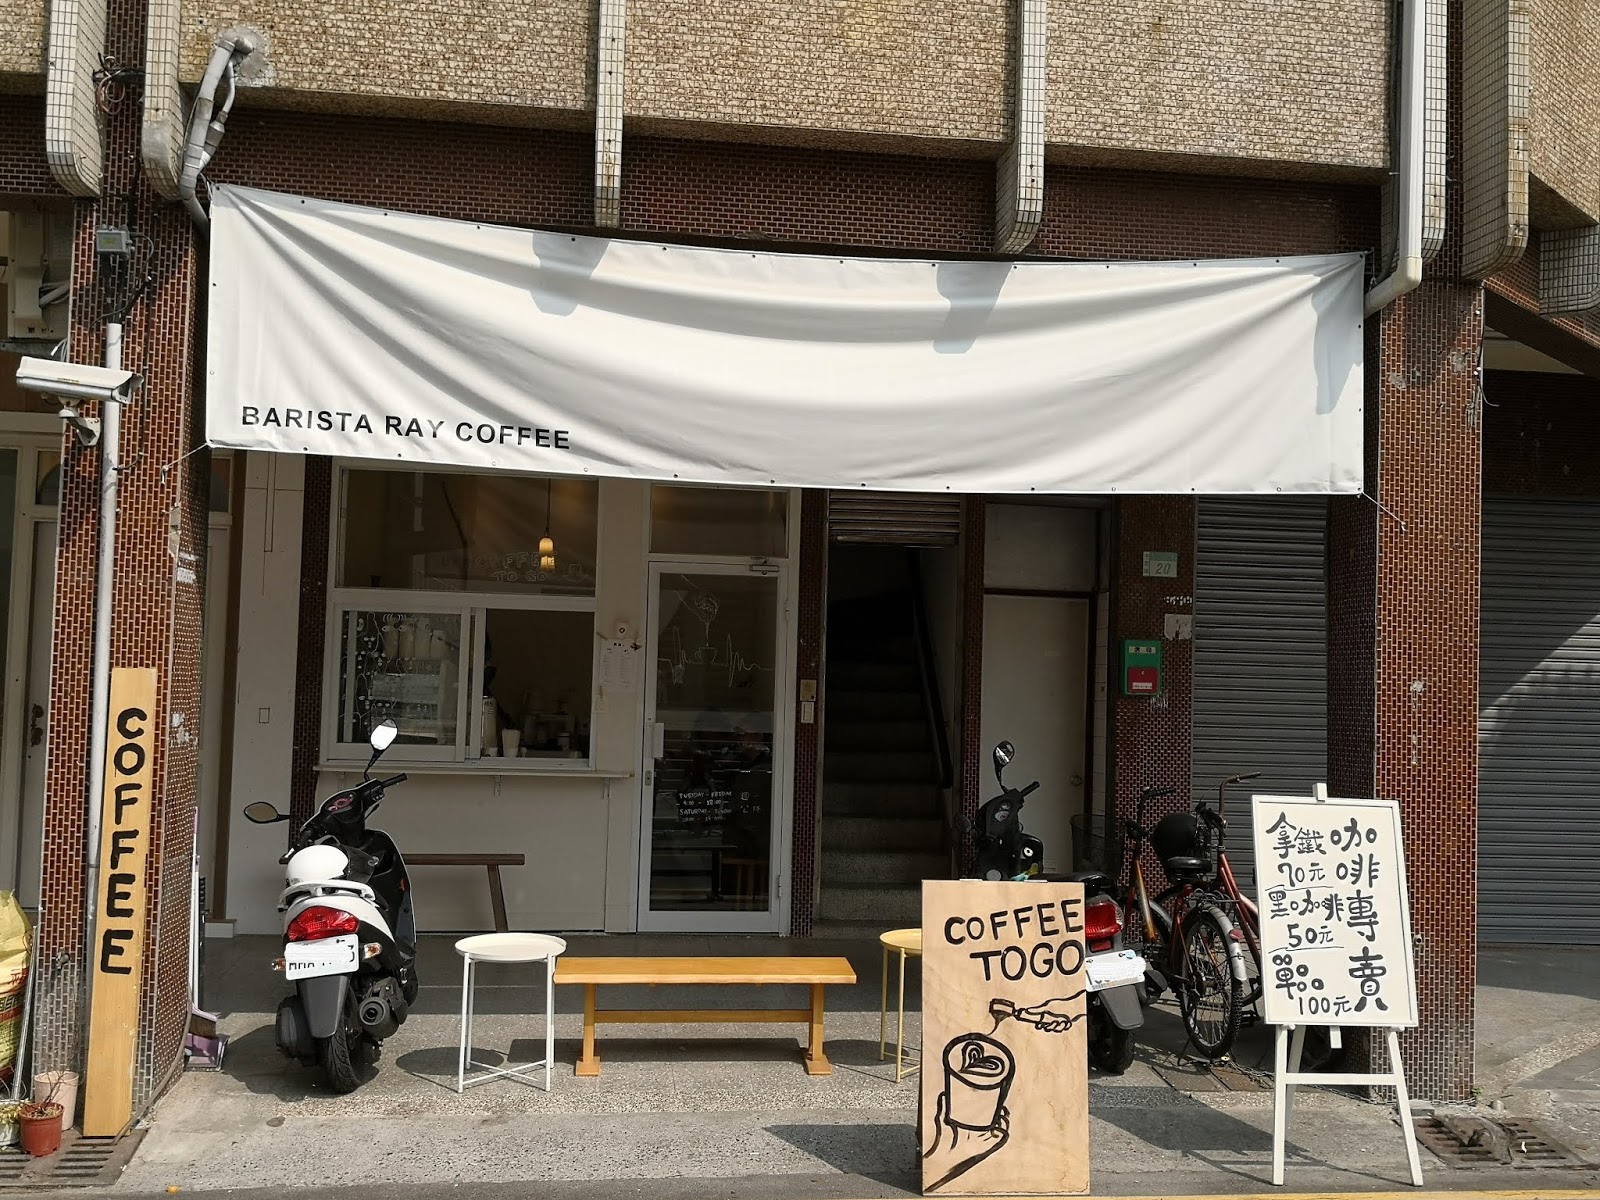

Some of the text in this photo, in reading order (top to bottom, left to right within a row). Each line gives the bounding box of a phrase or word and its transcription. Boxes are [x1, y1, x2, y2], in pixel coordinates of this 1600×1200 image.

[242, 406, 570, 450] BARISTA RAY COFFEE
[100, 707, 148, 975] COFFEE
[1265, 811, 1327, 859] 拿鐵
[944, 899, 1083, 945] COFFEE
[1268, 889, 1345, 922] 黑咖啡
[1330, 817, 1389, 1012] 咖啡專賣
